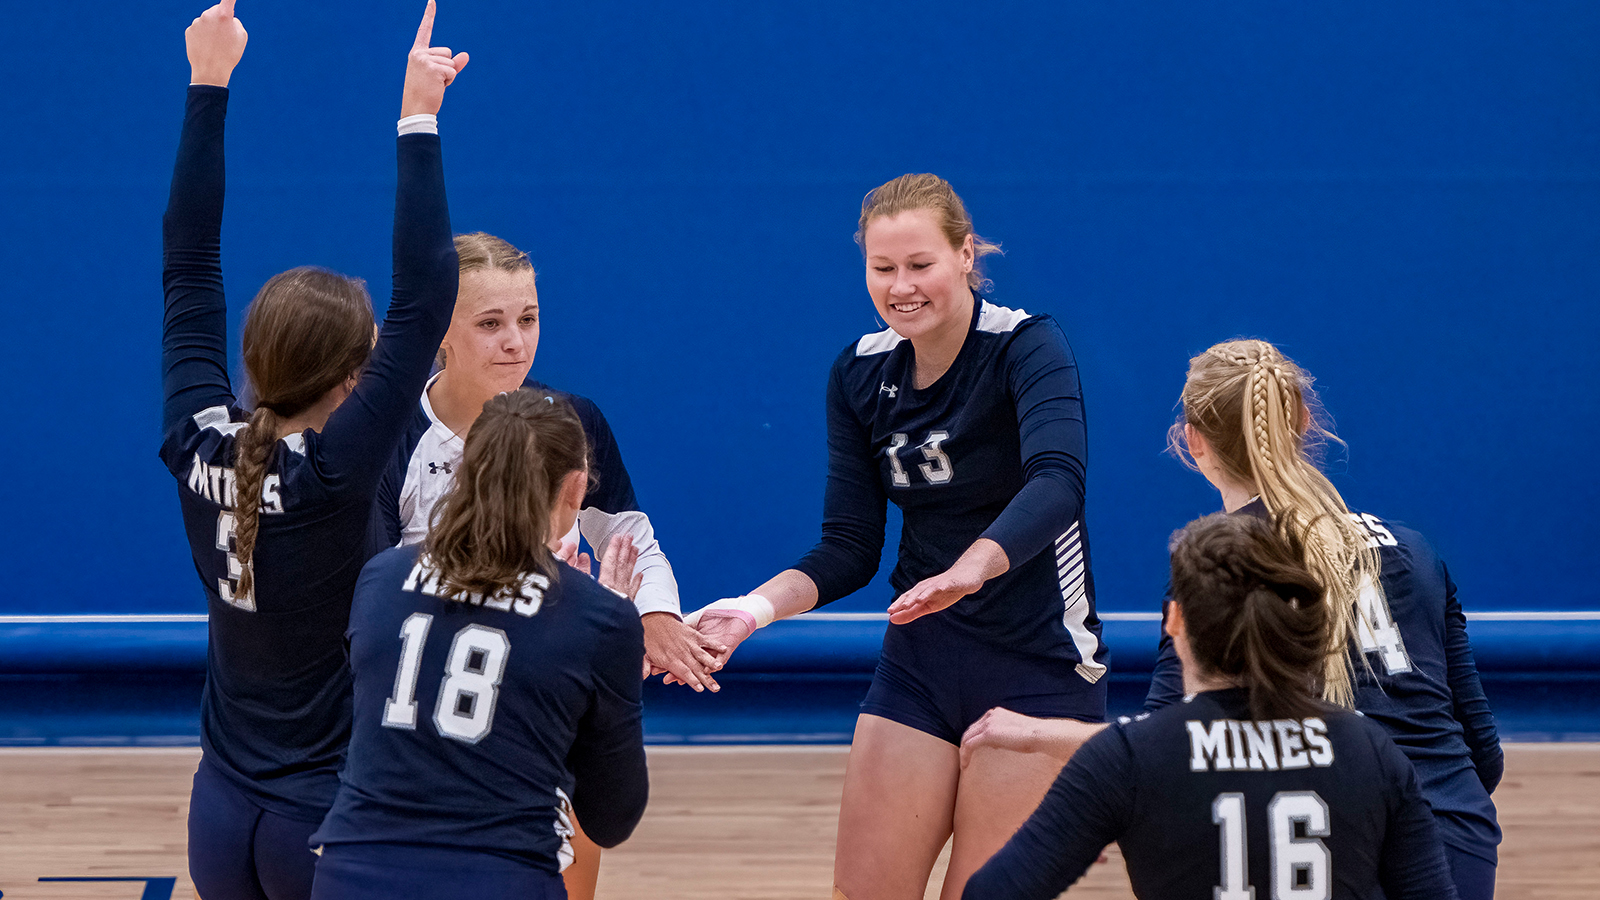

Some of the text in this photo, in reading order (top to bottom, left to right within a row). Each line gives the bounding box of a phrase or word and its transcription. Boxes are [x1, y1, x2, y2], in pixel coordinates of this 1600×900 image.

[187, 452, 285, 514] MIS
[215, 509, 257, 612] 3
[381, 611, 511, 745] 18
[1185, 717, 1335, 772] MINES
[1211, 790, 1332, 900] 16
